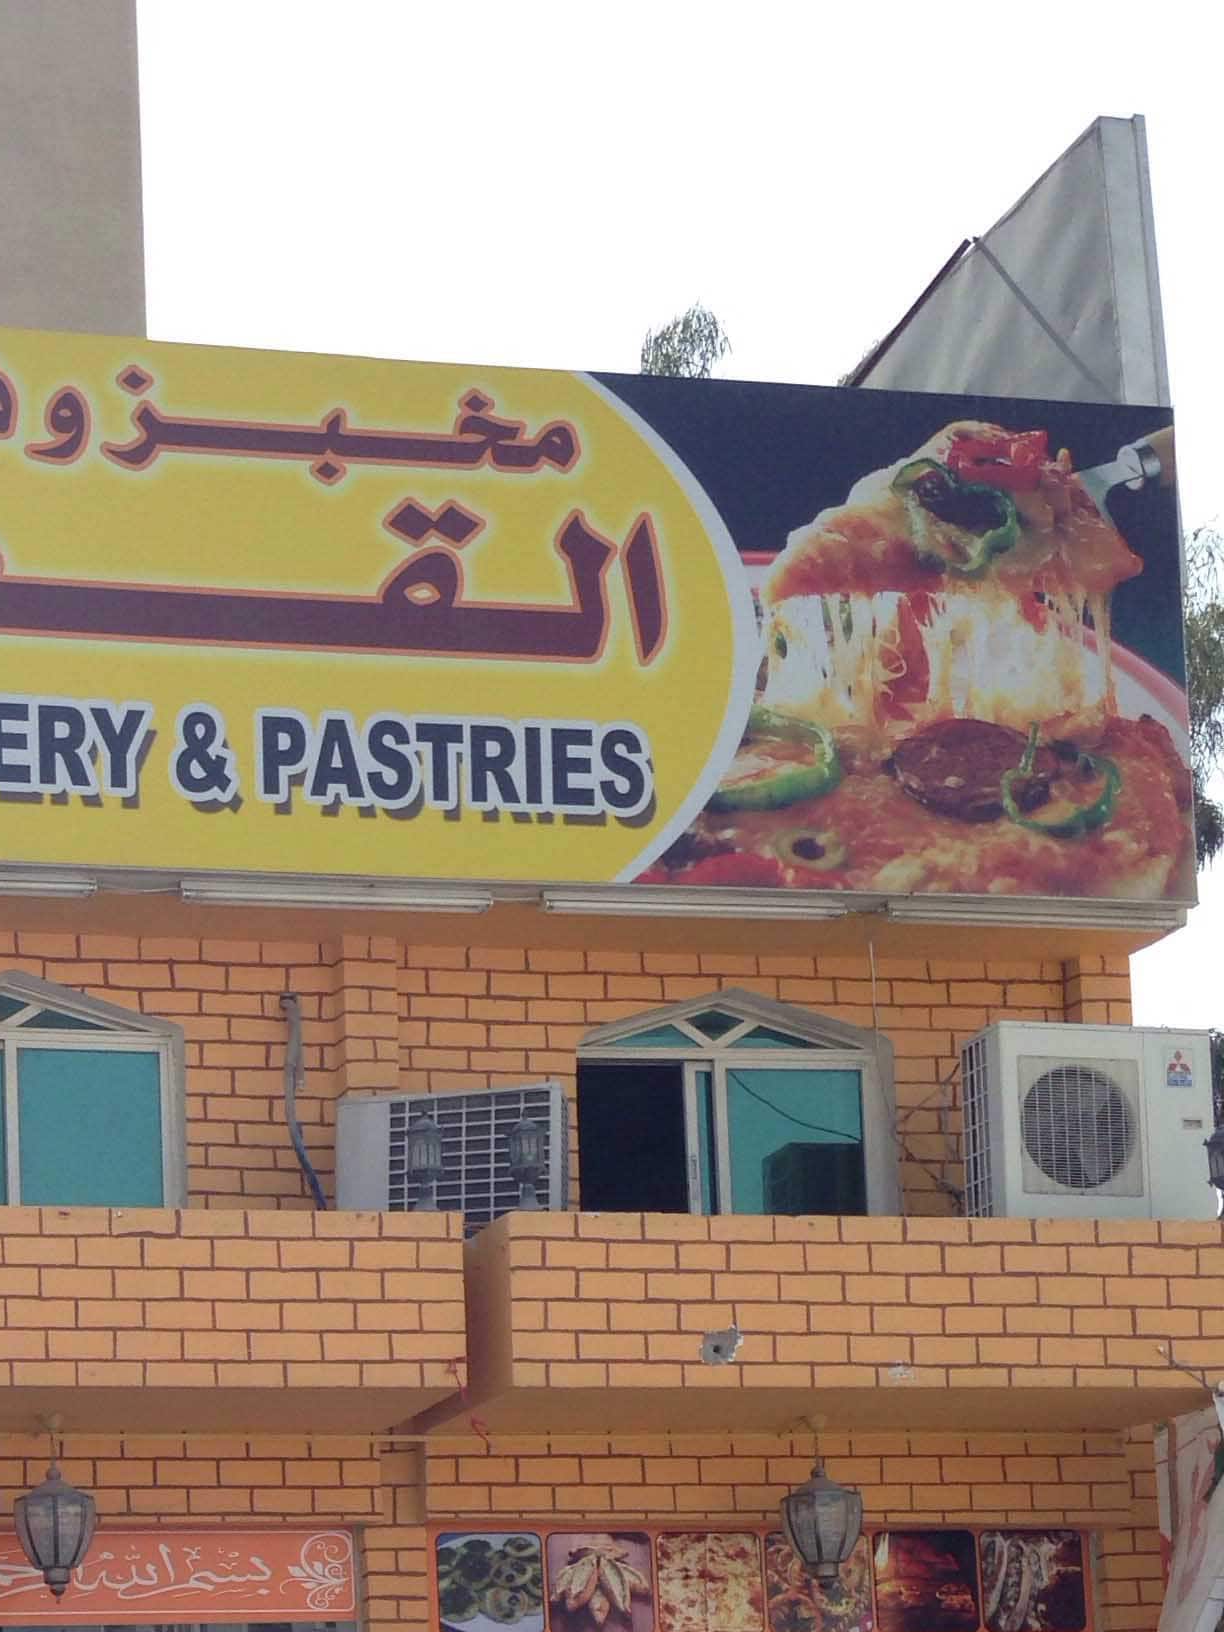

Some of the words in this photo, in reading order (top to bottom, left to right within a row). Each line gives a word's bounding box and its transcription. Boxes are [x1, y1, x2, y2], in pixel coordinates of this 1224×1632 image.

[100, 362, 581, 484] مخبز
[176, 709, 231, 795] &
[262, 714, 648, 811] PASTRIES
